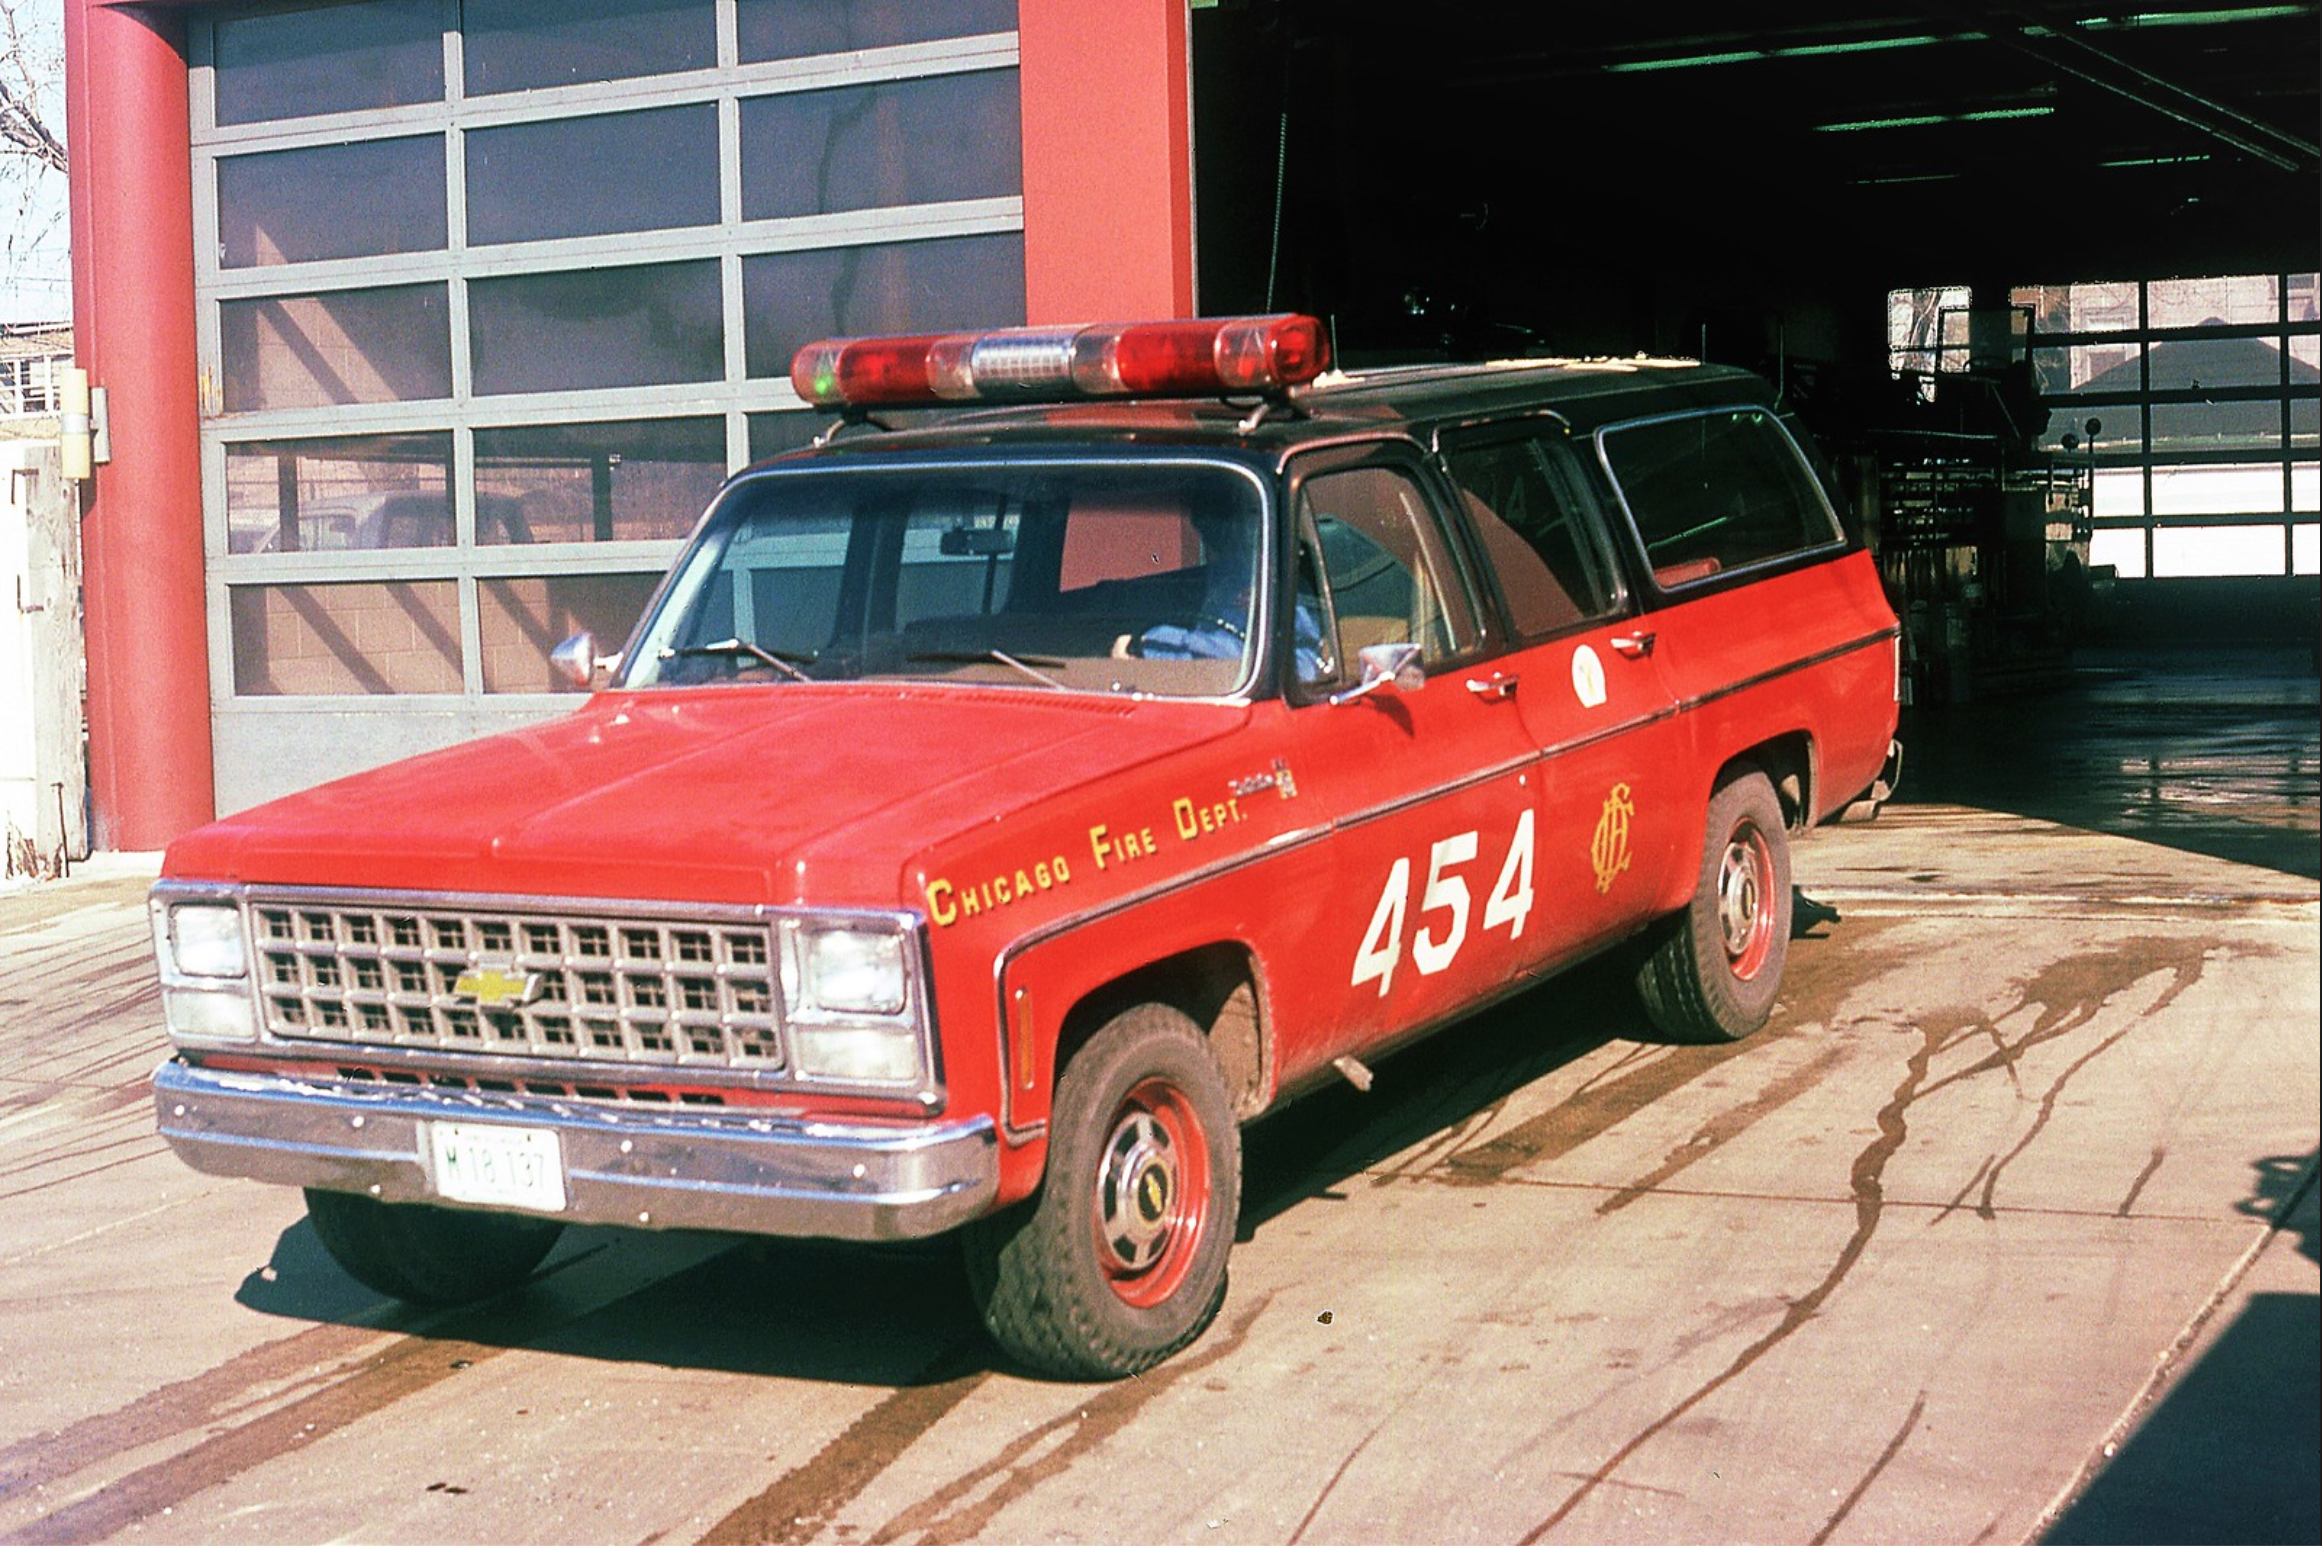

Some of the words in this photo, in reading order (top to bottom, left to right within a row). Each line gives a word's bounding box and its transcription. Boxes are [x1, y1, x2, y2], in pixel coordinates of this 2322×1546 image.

[926, 856, 1070, 926] CHICAGO
[1089, 825, 1157, 869] FIRE
[1173, 797, 1248, 840] DEPT.
[1351, 808, 1534, 998] 454
